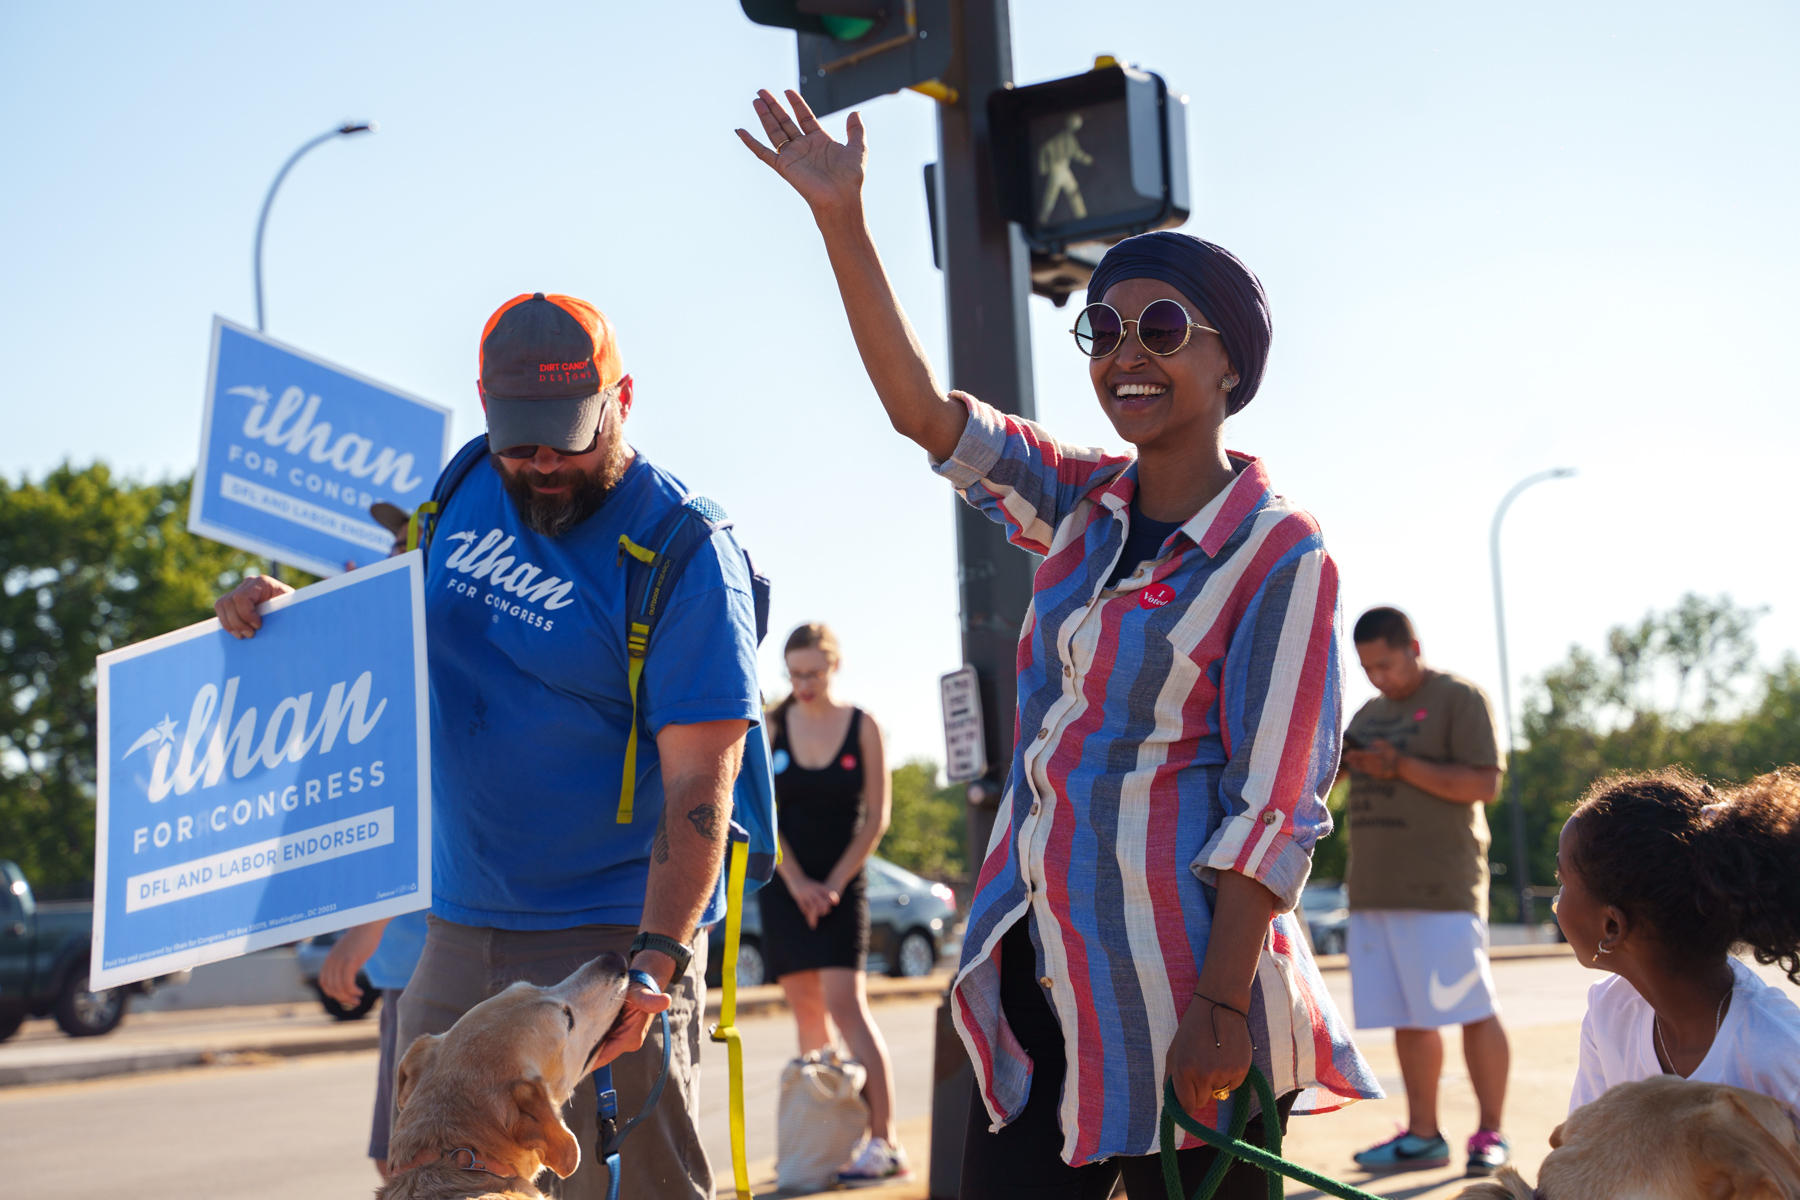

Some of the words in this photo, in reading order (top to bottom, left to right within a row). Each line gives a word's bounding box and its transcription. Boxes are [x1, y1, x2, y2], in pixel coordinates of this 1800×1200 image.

[539, 363, 560, 372] DIRT
[561, 361, 589, 371] CANDY
[539, 371, 592, 384] DESIGNS
[225, 385, 422, 494] ilhan
[228, 445, 278, 477] FOR
[289, 468, 385, 511] CONGR
[230, 483, 257, 504] DFL
[261, 494, 290, 515] AND
[292, 501, 338, 530] LABOR
[446, 528, 575, 611] ilhan
[648, 587, 660, 616] OUTDOOR
[656, 558, 671, 587] RESEARCH
[1144, 591, 1168, 605] Voted
[447, 579, 478, 599] FOR
[484, 594, 555, 632] CONGRESS
[121, 670, 388, 803] ilhan
[133, 815, 194, 854] FOR
[210, 761, 385, 832] CONGRESS
[140, 878, 171, 900] DFL
[177, 867, 213, 890] AND
[219, 850, 277, 878] LABOR
[283, 821, 379, 861] ENDORSED
[105, 959, 117, 967] Paid
[128, 954, 138, 962] and
[140, 946, 165, 960] prepared
[188, 939, 197, 948] for
[227, 929, 236, 938] PO
[237, 926, 248, 935] Box
[308, 908, 317, 917] DC
